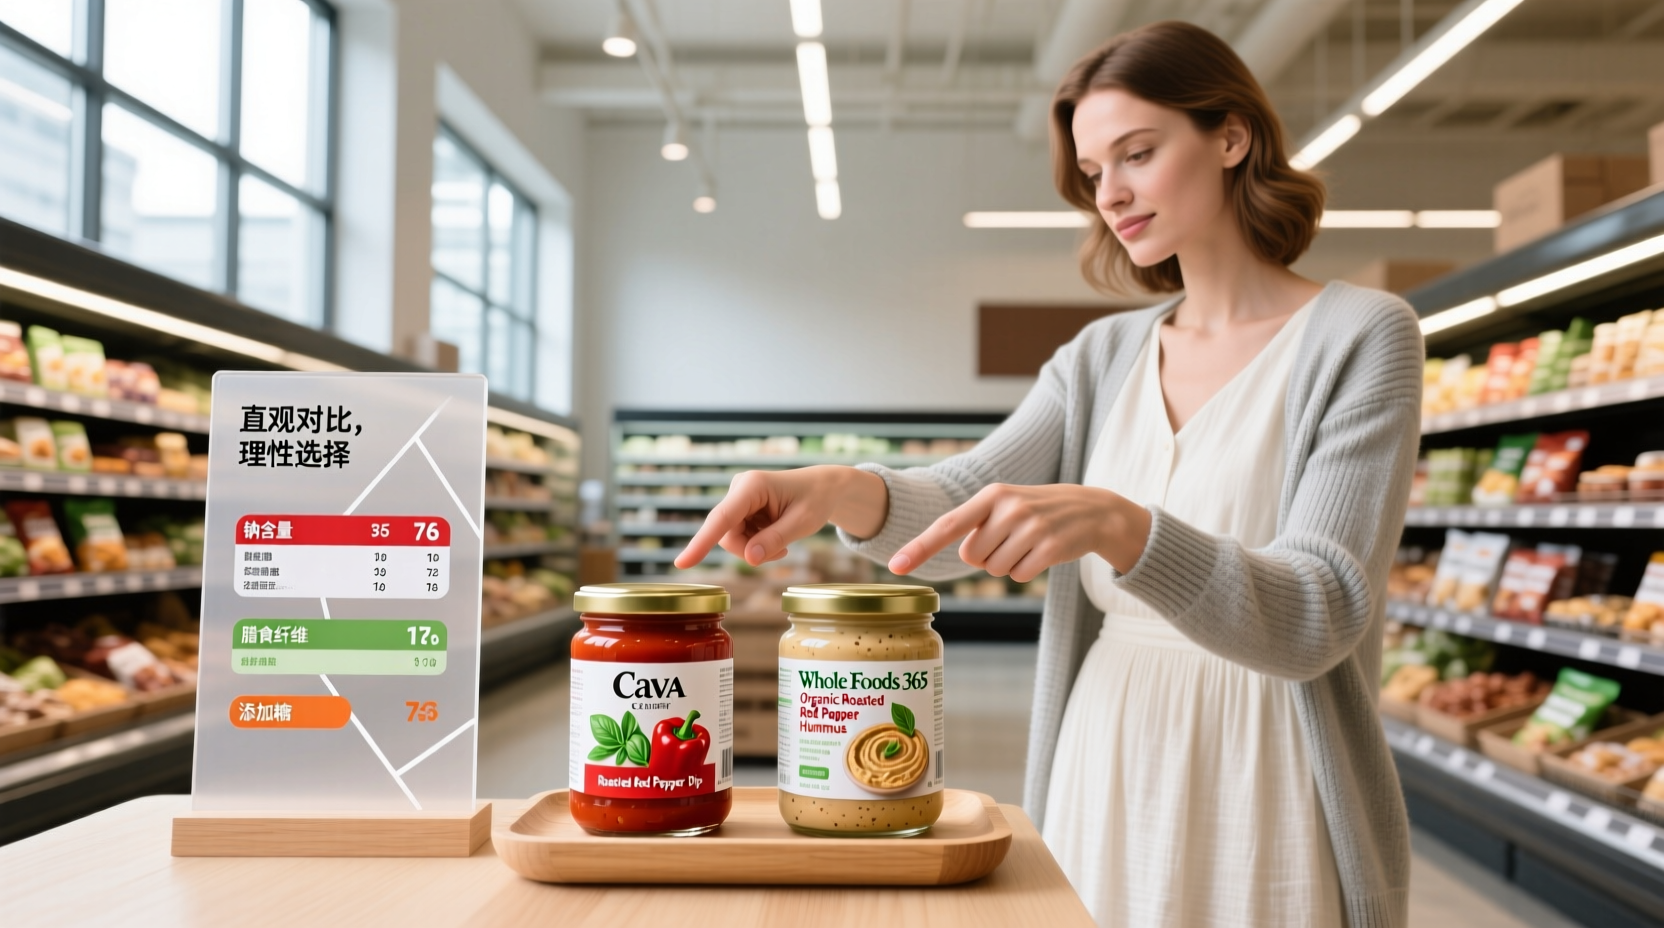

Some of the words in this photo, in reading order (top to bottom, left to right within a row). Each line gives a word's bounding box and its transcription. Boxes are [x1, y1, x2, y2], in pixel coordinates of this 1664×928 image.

[238, 439, 351, 469] 理性选择
[413, 522, 440, 541] 76
[799, 670, 848, 689] Whole
[850, 671, 900, 690] Foods
[902, 670, 928, 690] 365
[800, 692, 840, 707] Organic
[239, 701, 293, 722] 添加糖
[800, 720, 848, 733] Hummus
